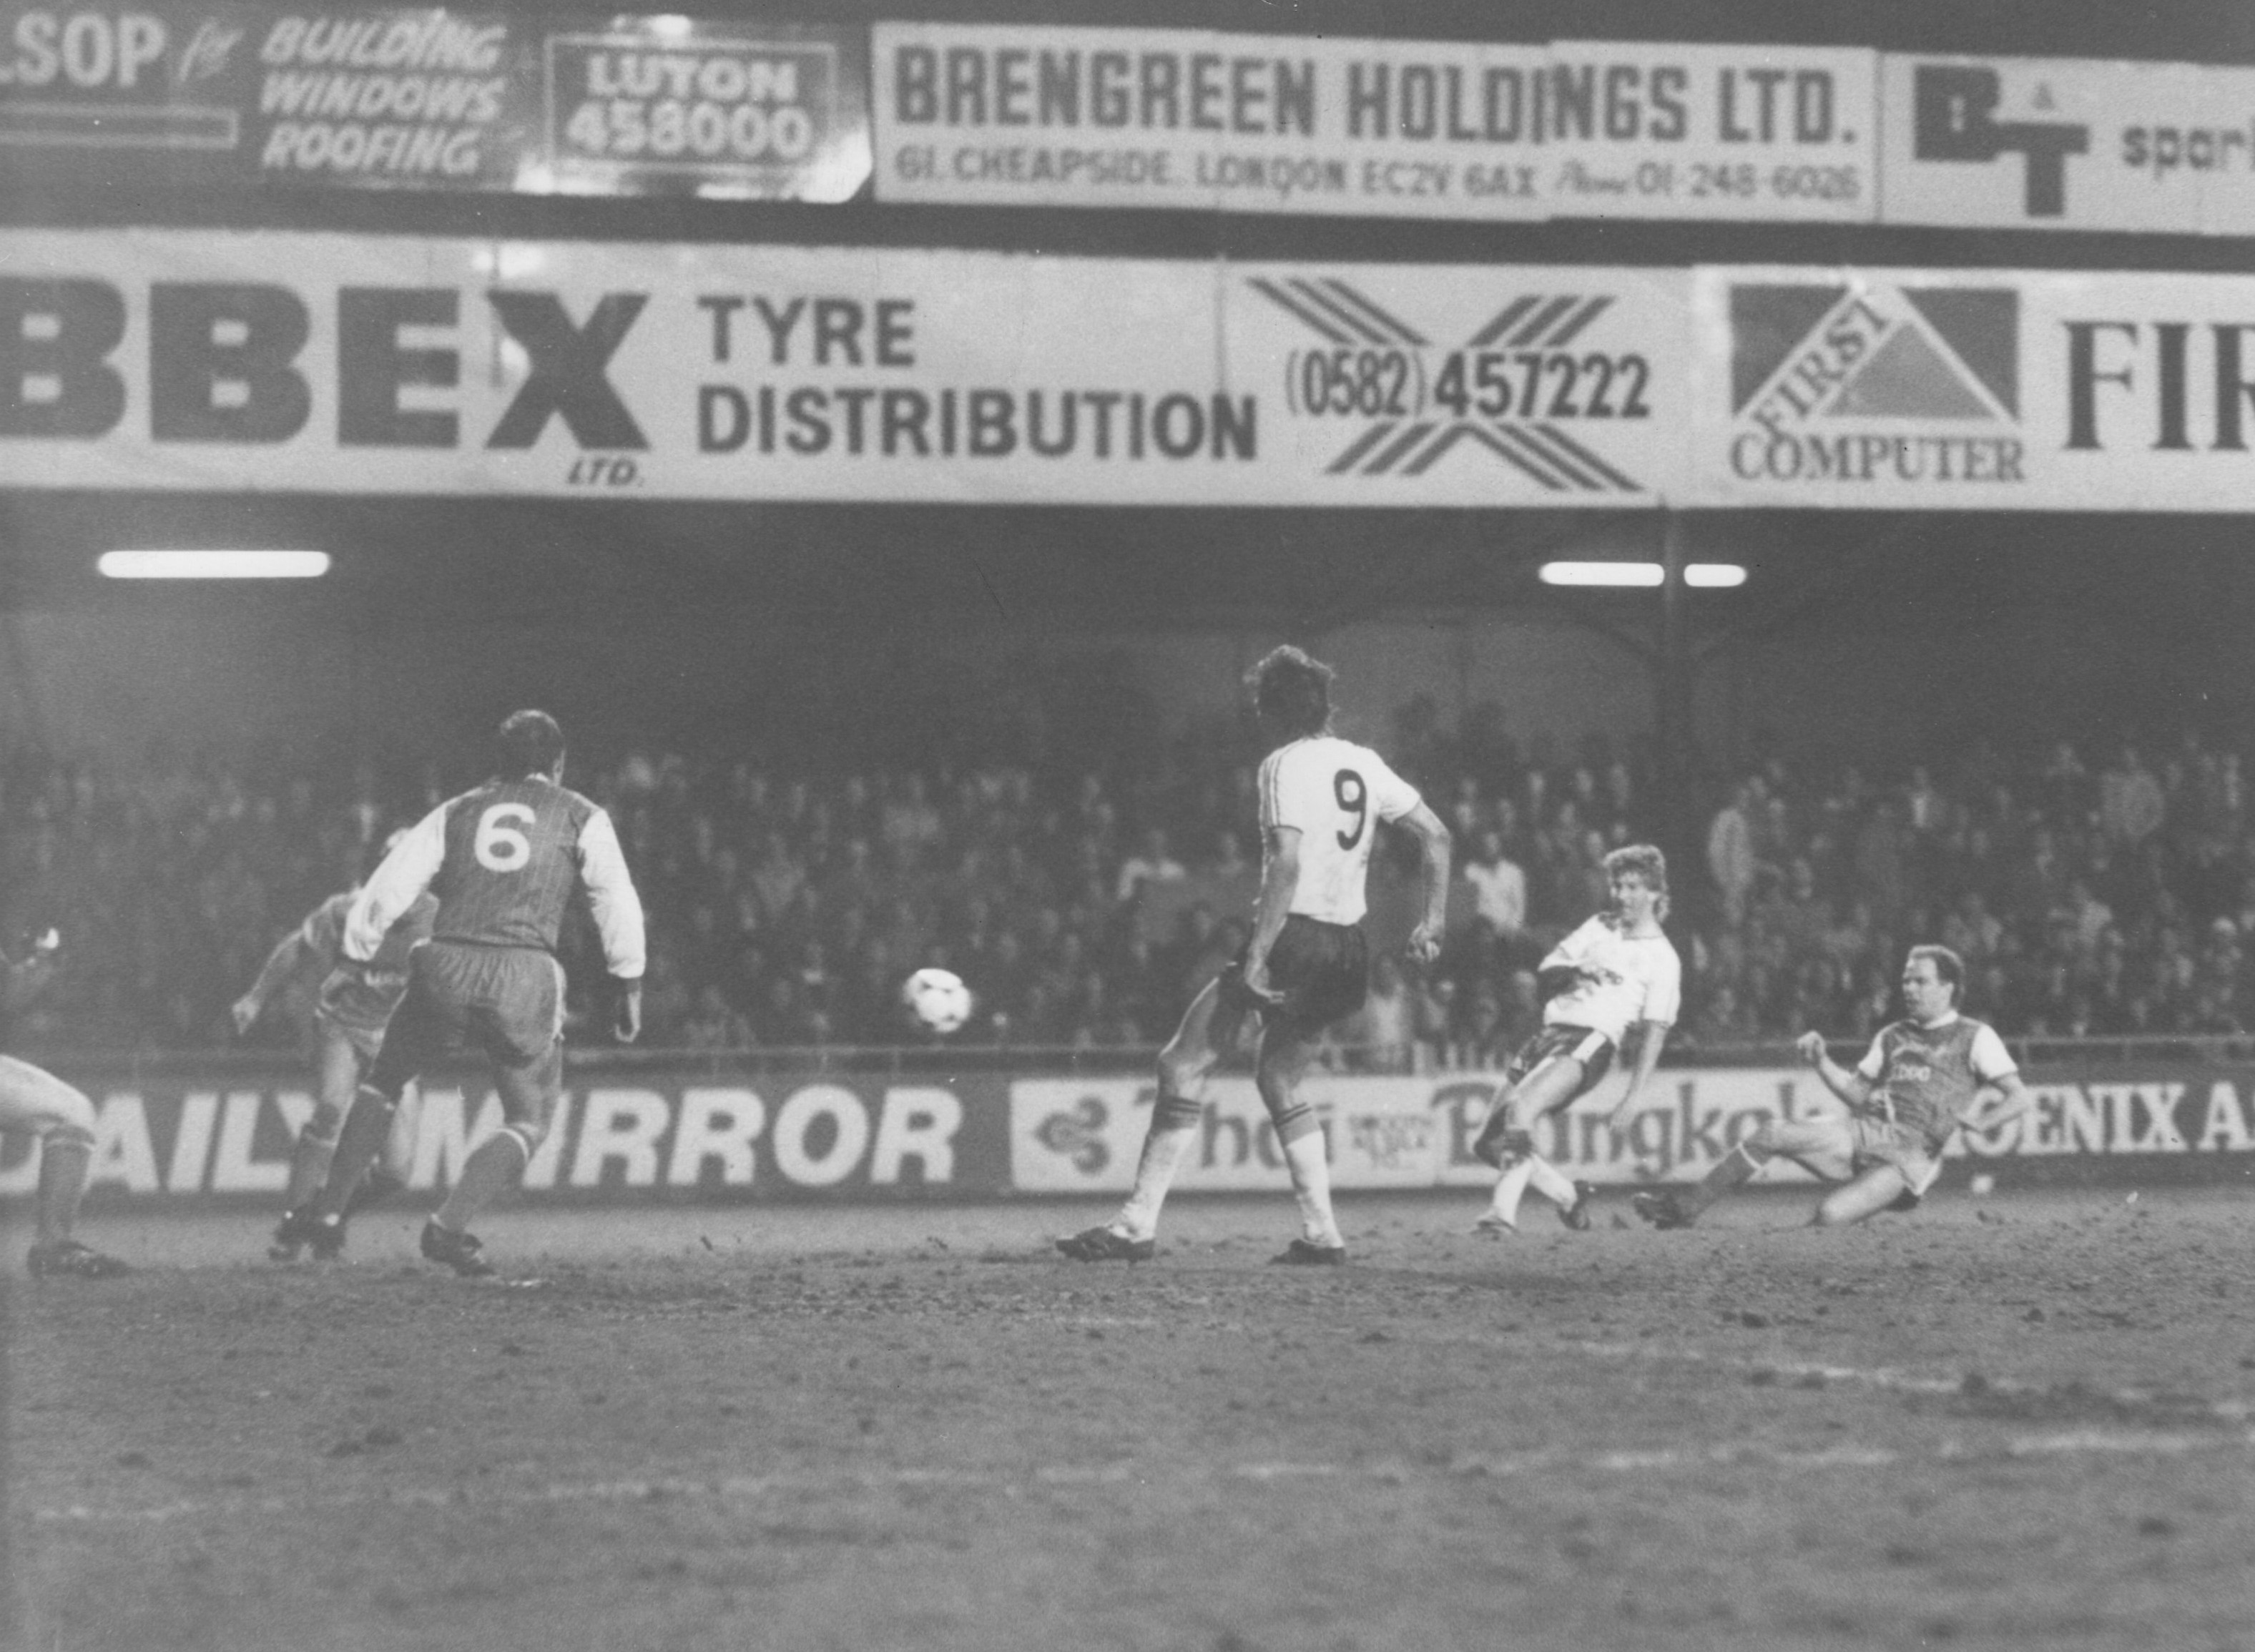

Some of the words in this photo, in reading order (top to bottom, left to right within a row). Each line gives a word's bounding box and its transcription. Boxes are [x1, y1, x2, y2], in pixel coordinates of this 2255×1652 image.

[0, 12, 167, 87] SOP
[260, 16, 506, 70] BUILDING
[586, 52, 799, 102] LUTON
[260, 72, 503, 122] WINDOWS
[567, 98, 813, 157] 458000
[895, 44, 1316, 137] BRENGREEN
[1346, 60, 1689, 144] HOLDINGS
[1718, 67, 1857, 144] LTD.
[261, 122, 483, 174] ROOFING
[1195, 149, 1347, 195] LONDON
[2120, 123, 2255, 182] spor
[697, 293, 916, 368] TYRE
[1288, 348, 1425, 419] (0582)
[1433, 350, 1651, 420] 457222
[1752, 295, 1892, 439] FIRST
[697, 383, 1258, 461] DISTRIBUTION
[1729, 431, 2026, 483] COMPUTER
[474, 802, 536, 872] 6
[1333, 768, 1367, 851] 9
[2196, 1080, 2255, 1152] A
